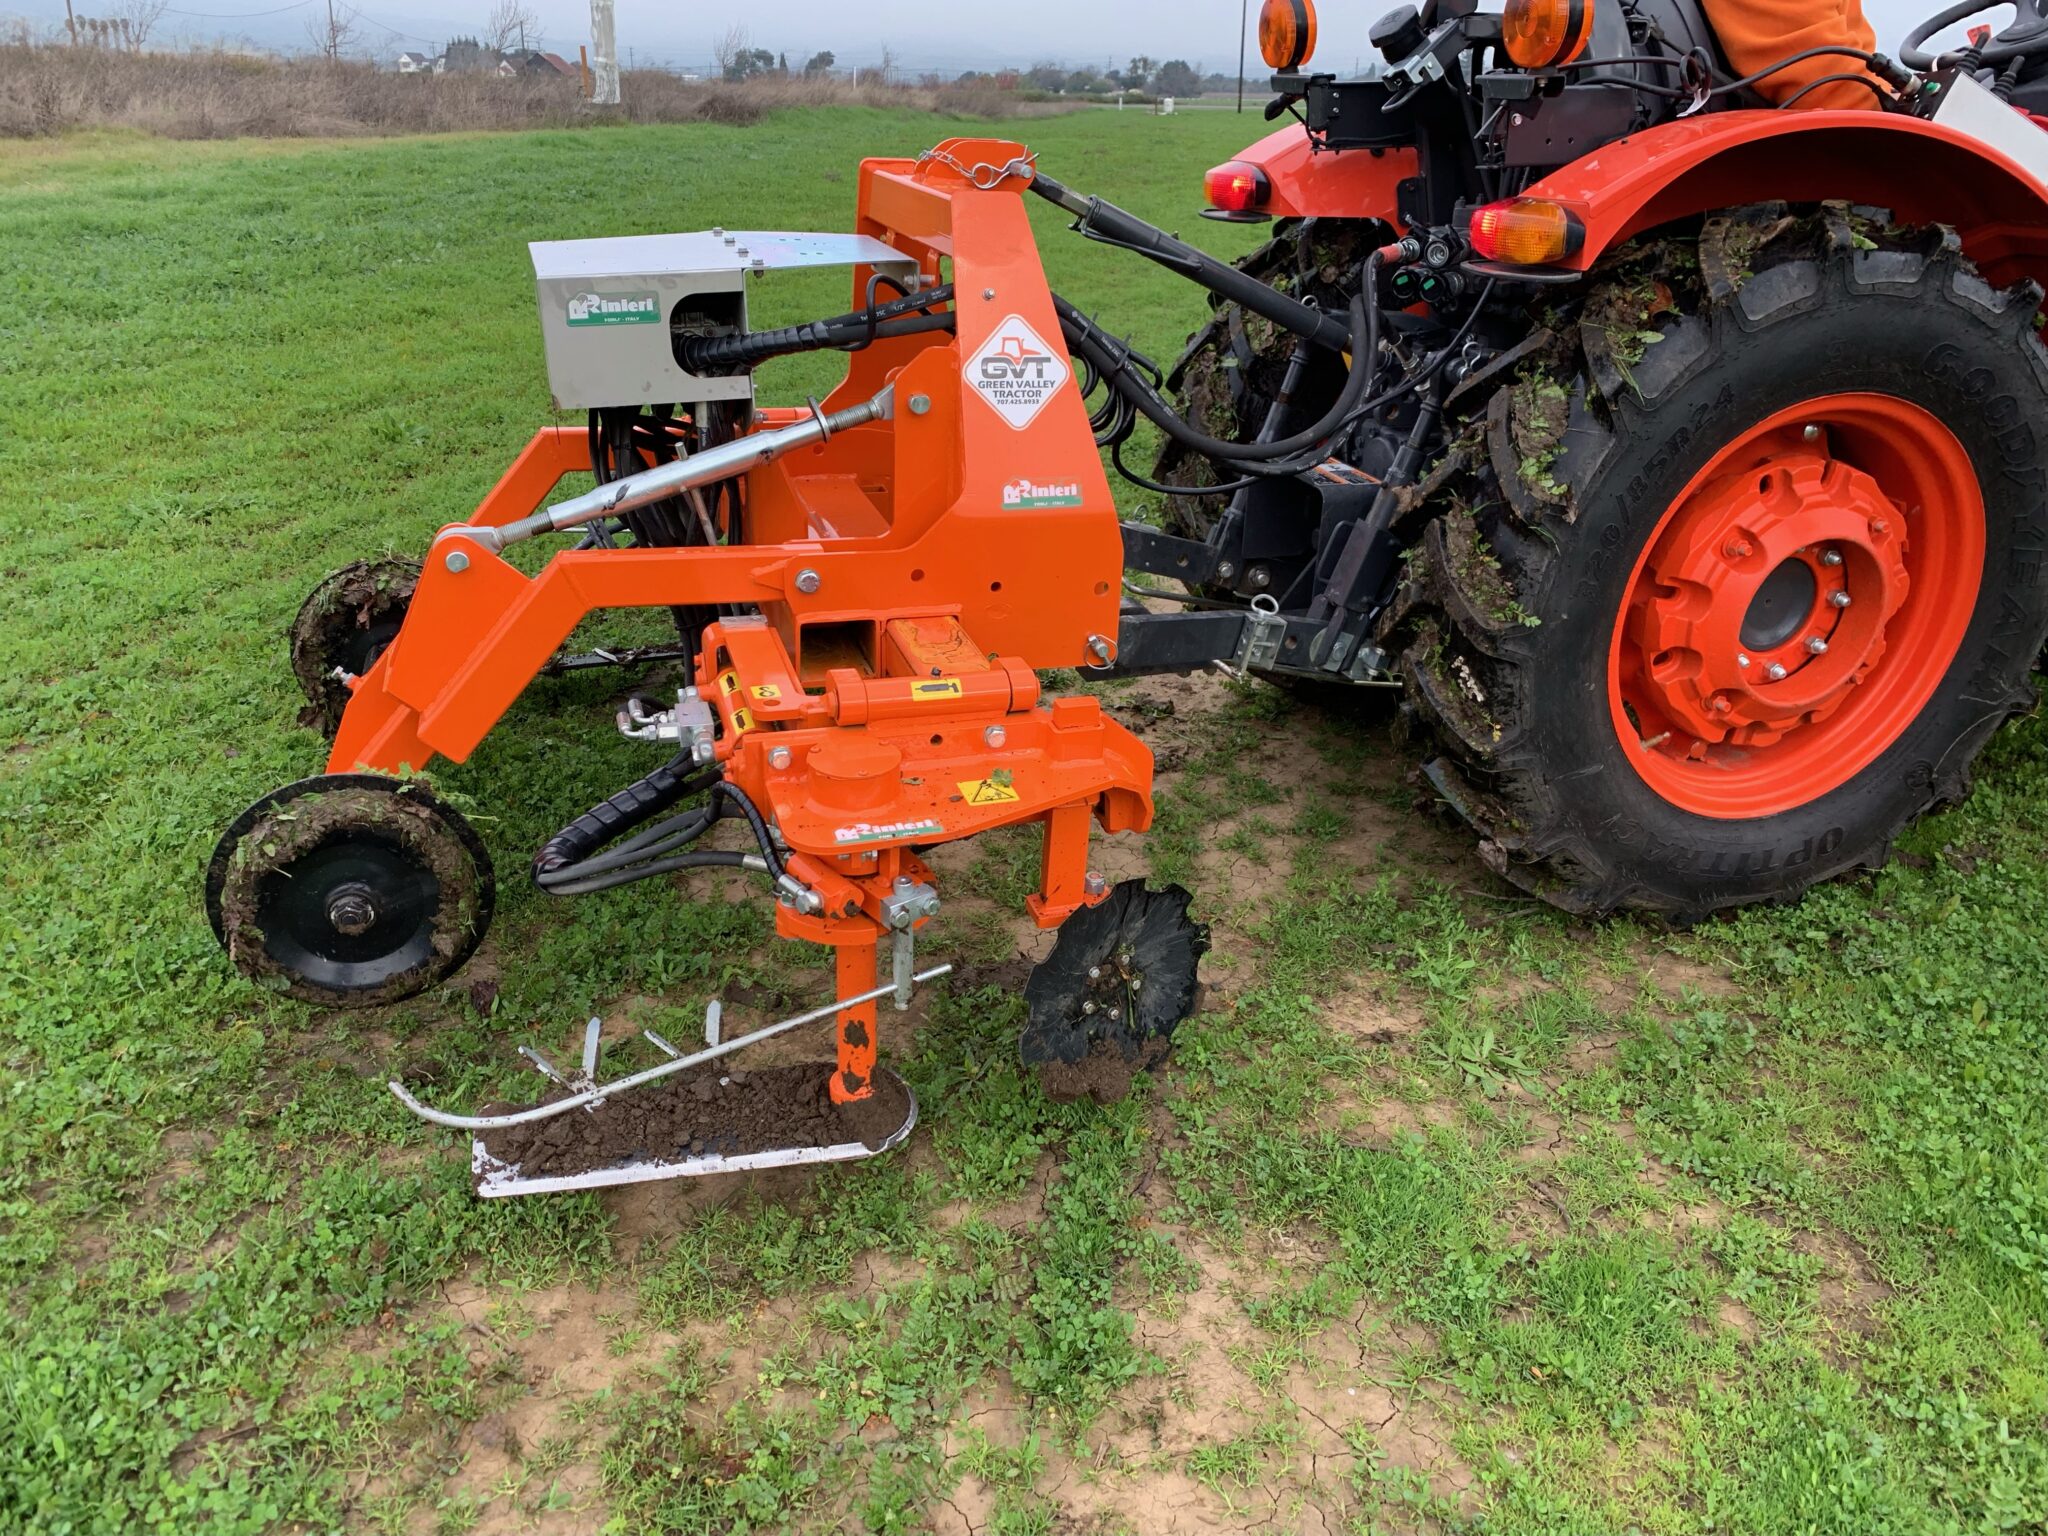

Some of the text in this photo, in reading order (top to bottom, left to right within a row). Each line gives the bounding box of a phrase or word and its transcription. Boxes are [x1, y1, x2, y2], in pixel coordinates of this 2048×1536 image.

[582, 294, 654, 315] Rinieri
[981, 357, 1051, 379] GVT
[978, 380, 1056, 389] GREEN VALLEY
[992, 390, 1042, 398] TRACTOR
[1921, 343, 2046, 692] GOODYEAR
